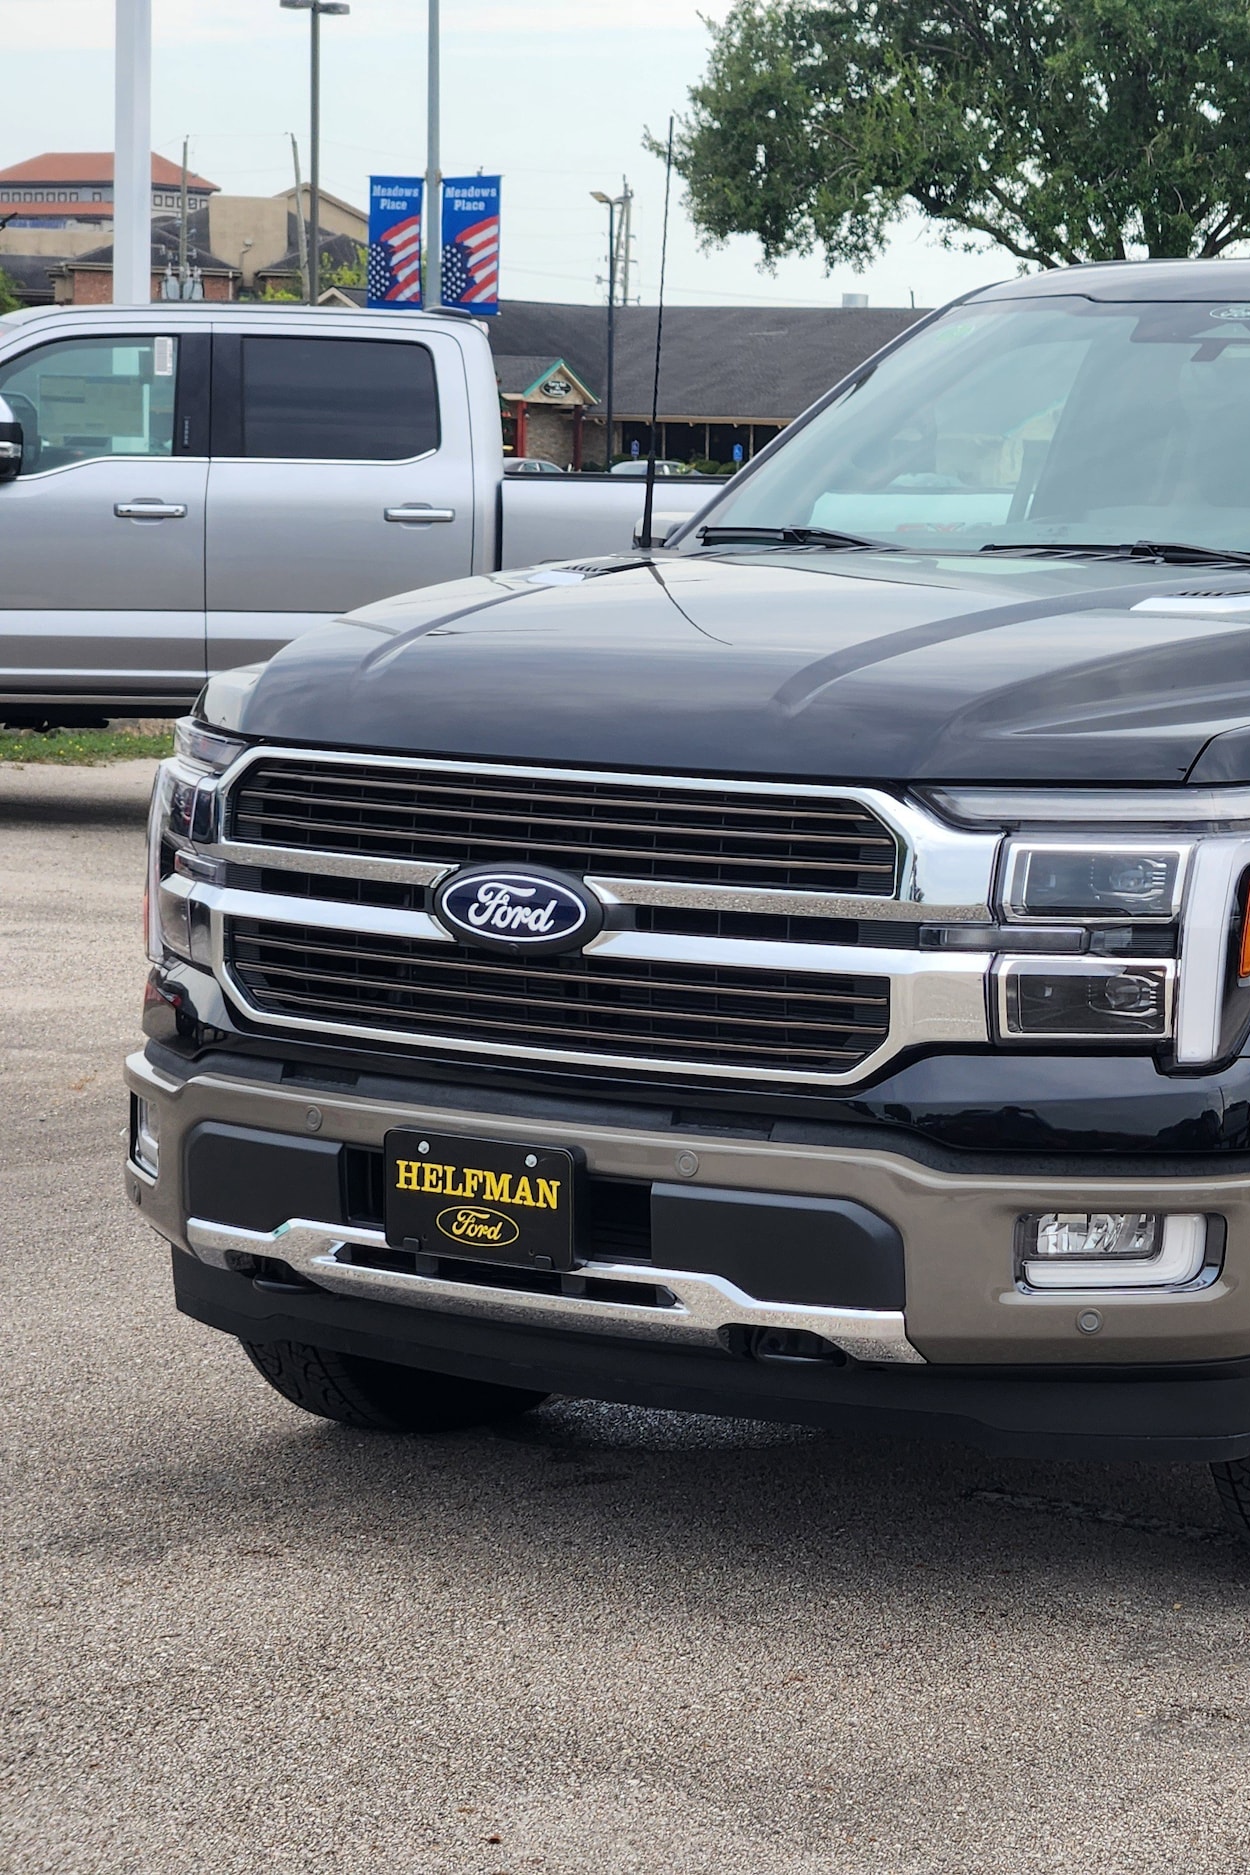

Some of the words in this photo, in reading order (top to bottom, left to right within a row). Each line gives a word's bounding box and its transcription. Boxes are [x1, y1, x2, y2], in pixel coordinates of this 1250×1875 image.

[372, 185, 419, 197] Meadows
[445, 186, 497, 198] Meadows
[380, 198, 407, 210] Place
[453, 199, 485, 211] Place
[467, 882, 555, 933] Ford
[395, 1159, 562, 1210] HELFMAN
[451, 1209, 503, 1241] Ford
